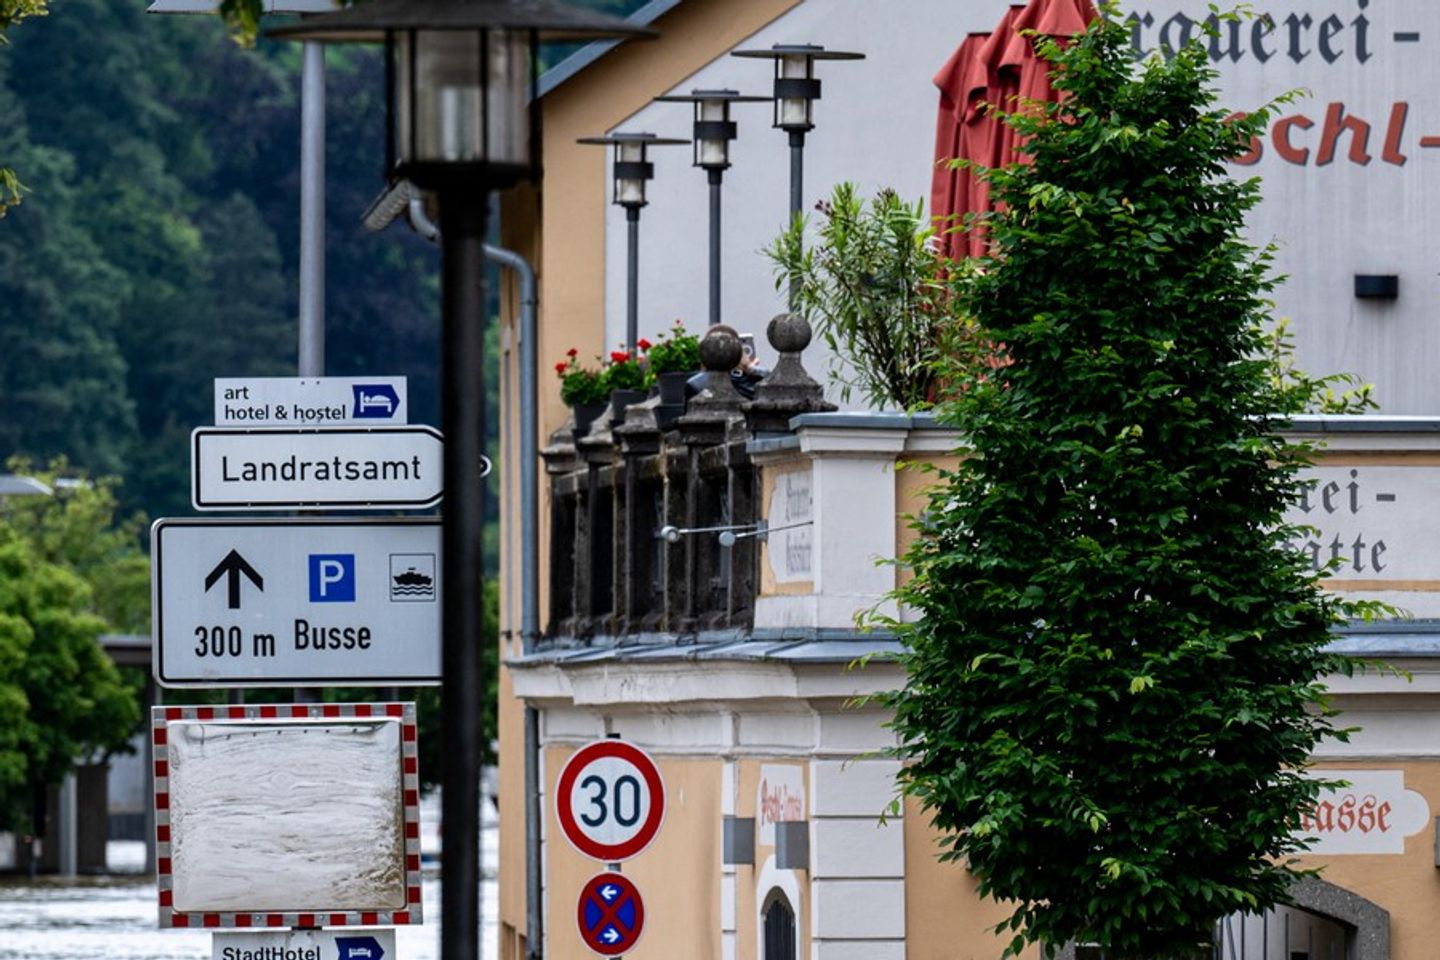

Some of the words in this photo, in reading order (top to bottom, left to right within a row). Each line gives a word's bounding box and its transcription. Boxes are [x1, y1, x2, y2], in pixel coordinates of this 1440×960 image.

[224, 386, 249, 400] art
[225, 405, 269, 420] hotel
[274, 406, 288, 420] &
[293, 405, 347, 420] hostel
[222, 455, 421, 482] Landratsamt
[319, 560, 345, 597] P
[194, 626, 242, 657] 300
[253, 634, 276, 657] m
[294, 619, 371, 650] Busse
[580, 774, 642, 828] 30
